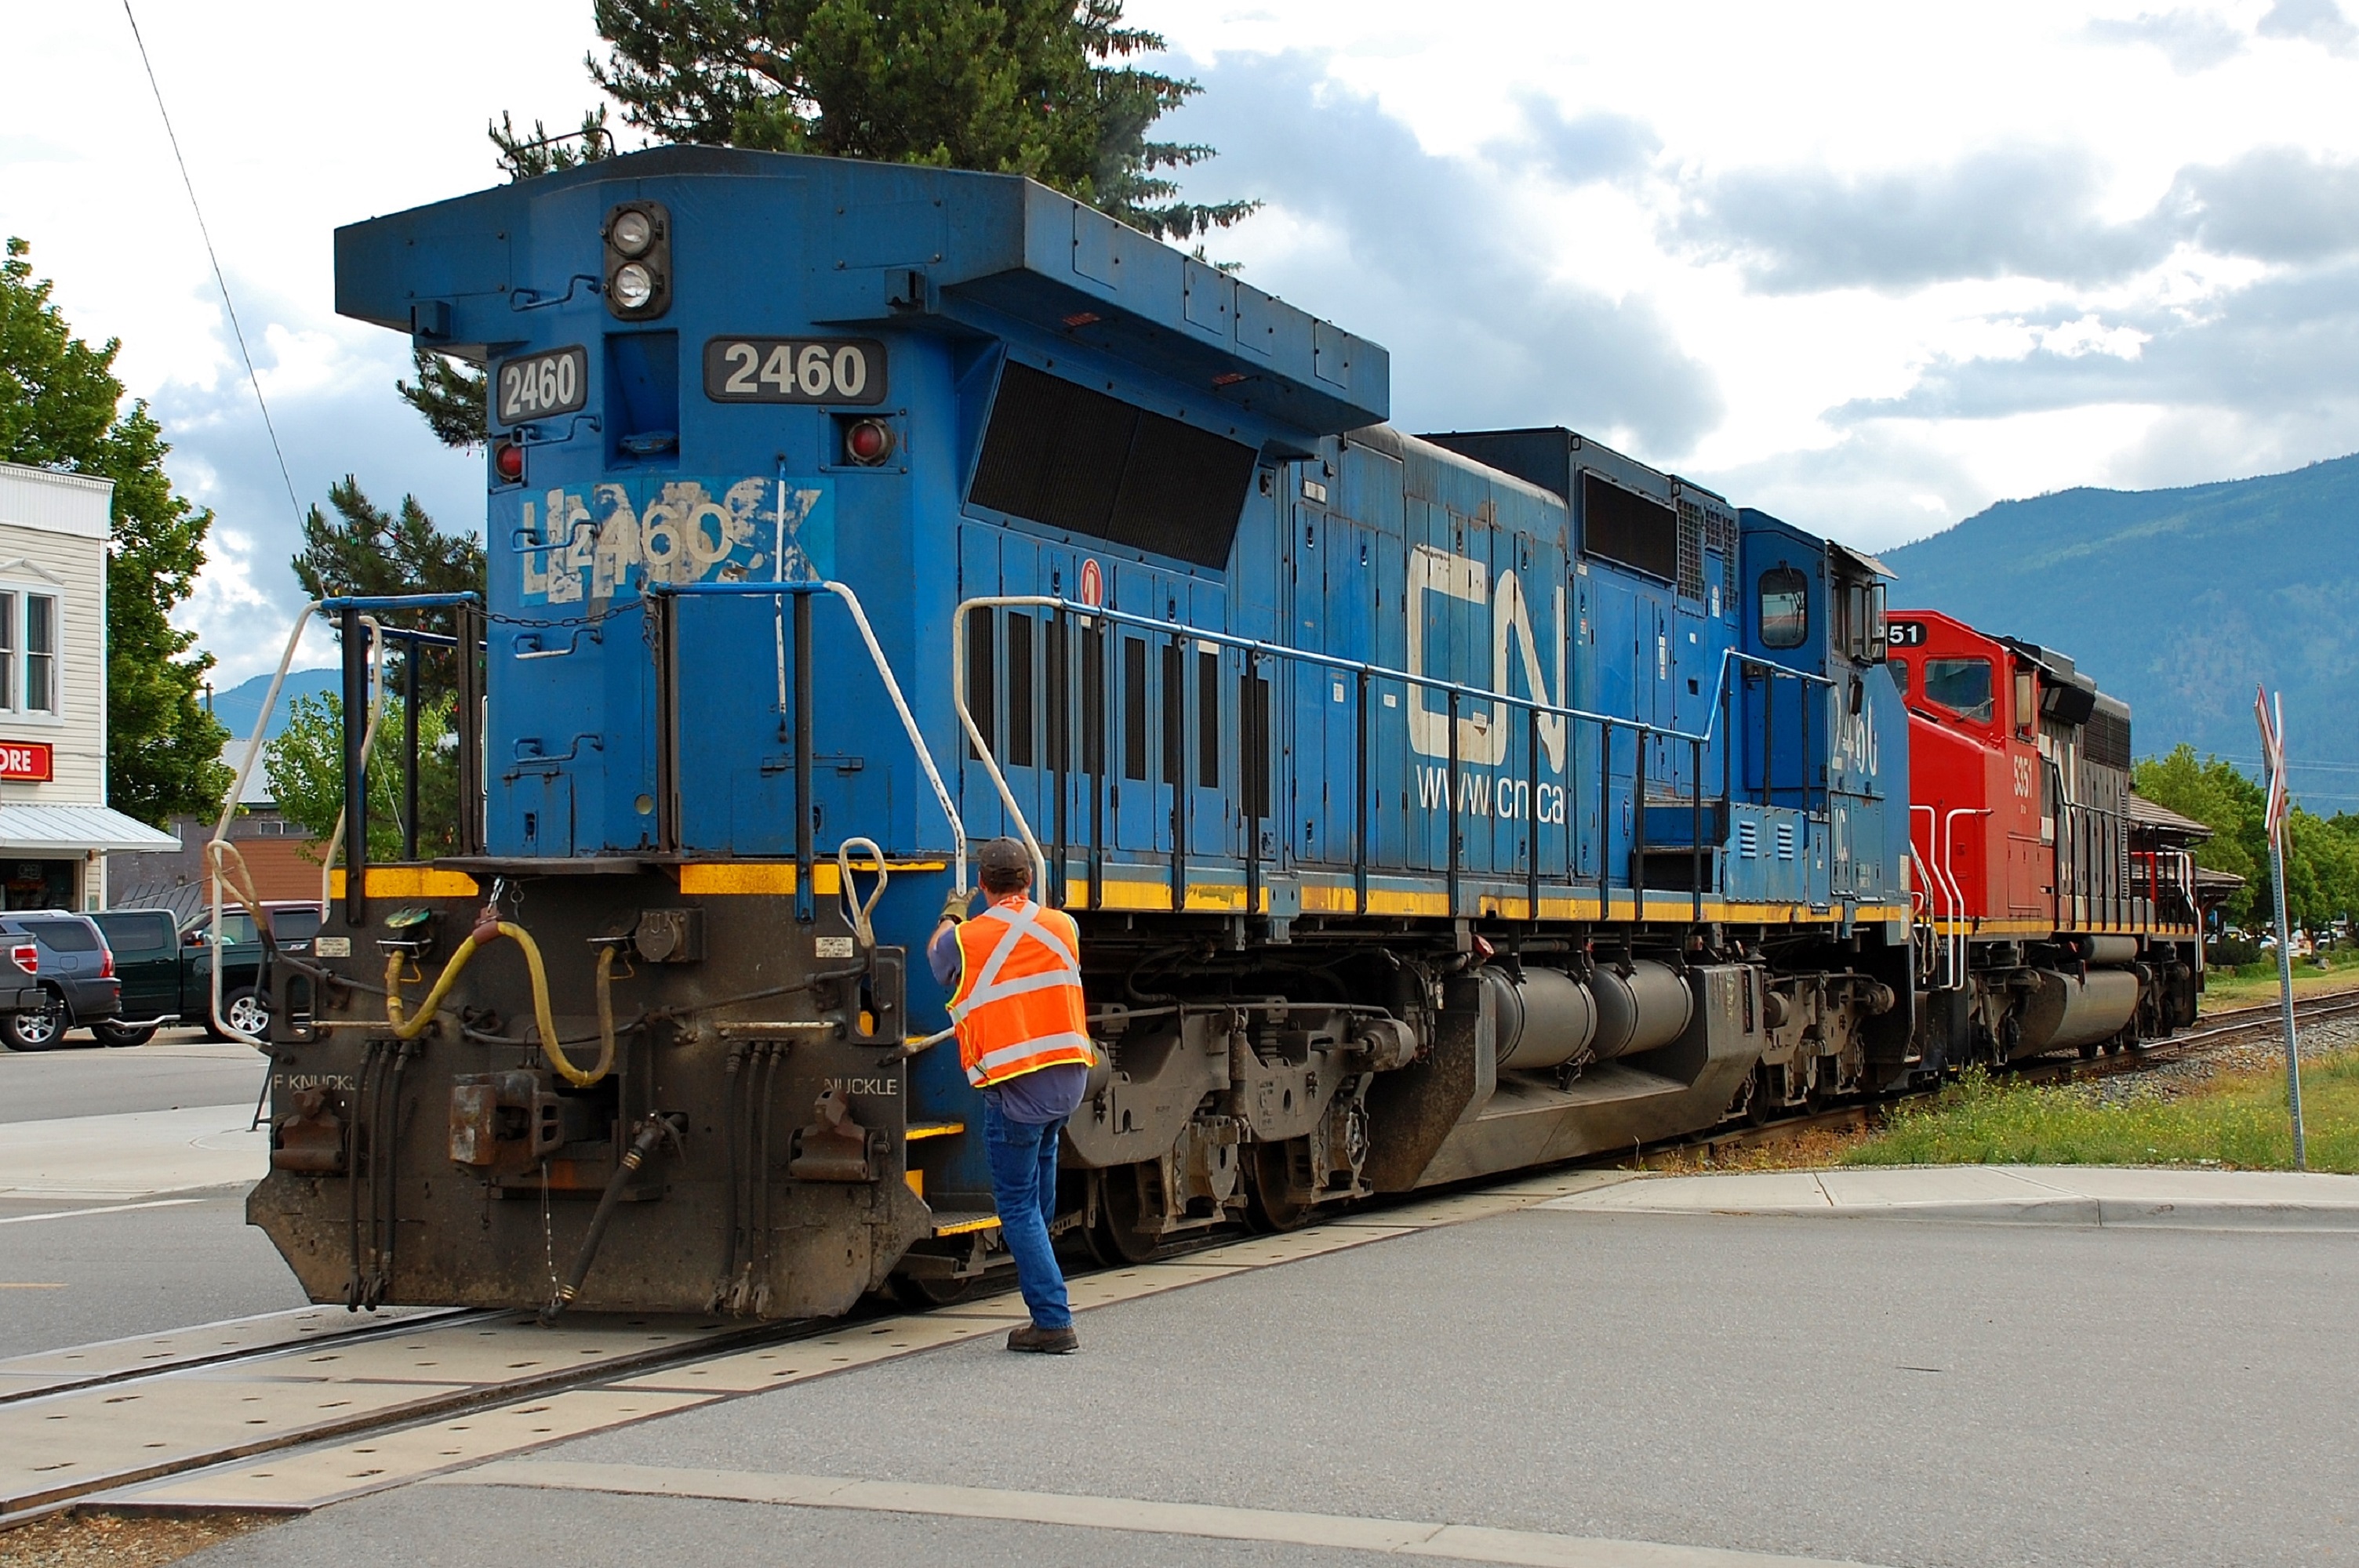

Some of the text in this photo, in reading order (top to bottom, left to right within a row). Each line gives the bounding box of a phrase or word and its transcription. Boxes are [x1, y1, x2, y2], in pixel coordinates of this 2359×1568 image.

[505, 354, 576, 416] 2460
[725, 343, 867, 397] 2460
[568, 503, 734, 585] 2460
[1408, 543, 1565, 774] CN
[0, 748, 31, 771] ORE
[2013, 754, 2033, 798] 5351
